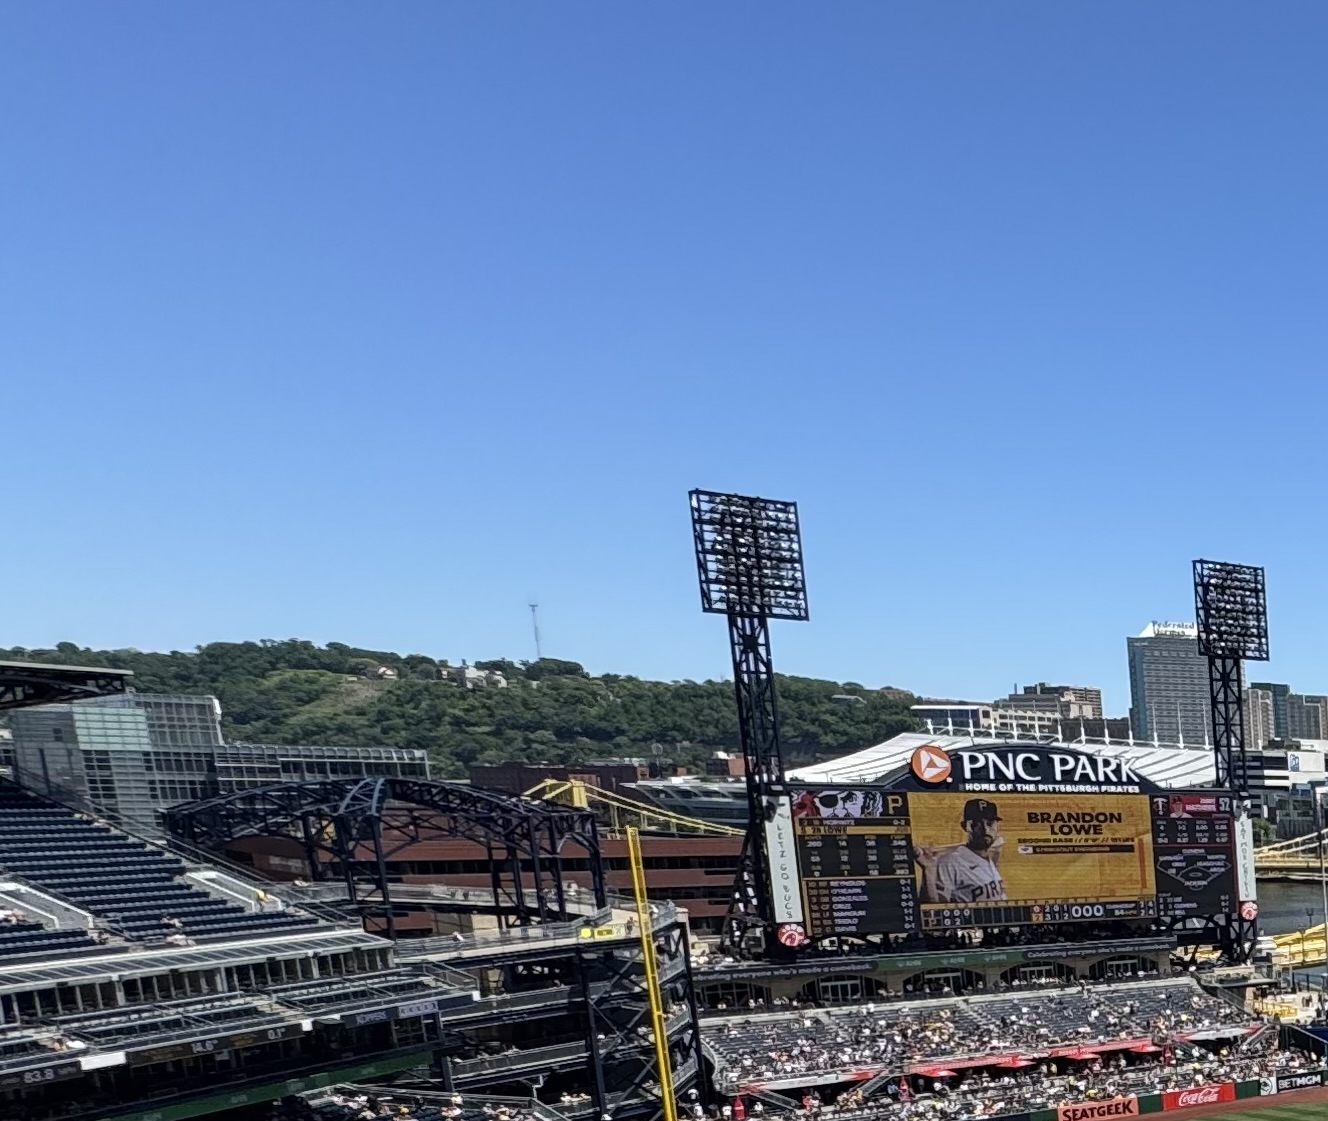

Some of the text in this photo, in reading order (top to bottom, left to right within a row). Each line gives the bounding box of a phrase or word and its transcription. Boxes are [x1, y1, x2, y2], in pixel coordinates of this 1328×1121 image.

[958, 751, 1140, 783] PNC PARK
[965, 783, 1140, 794] HOME OF THE PITTSBURGH PIRATES
[1027, 812, 1122, 823] BRANDON
[1050, 824, 1103, 835] LOWE
[780, 863, 790, 880] GO
[783, 885, 793, 919] BUCS
[943, 909, 950, 917] 0
[953, 909, 960, 917] 0
[964, 908, 970, 917] 0
[1028, 950, 1067, 958] Celebrating
[733, 970, 771, 979] everyone
[798, 966, 822, 974] made
[24, 1068, 54, 1083] 83.8
[1277, 1074, 1321, 1089] BETMGM
